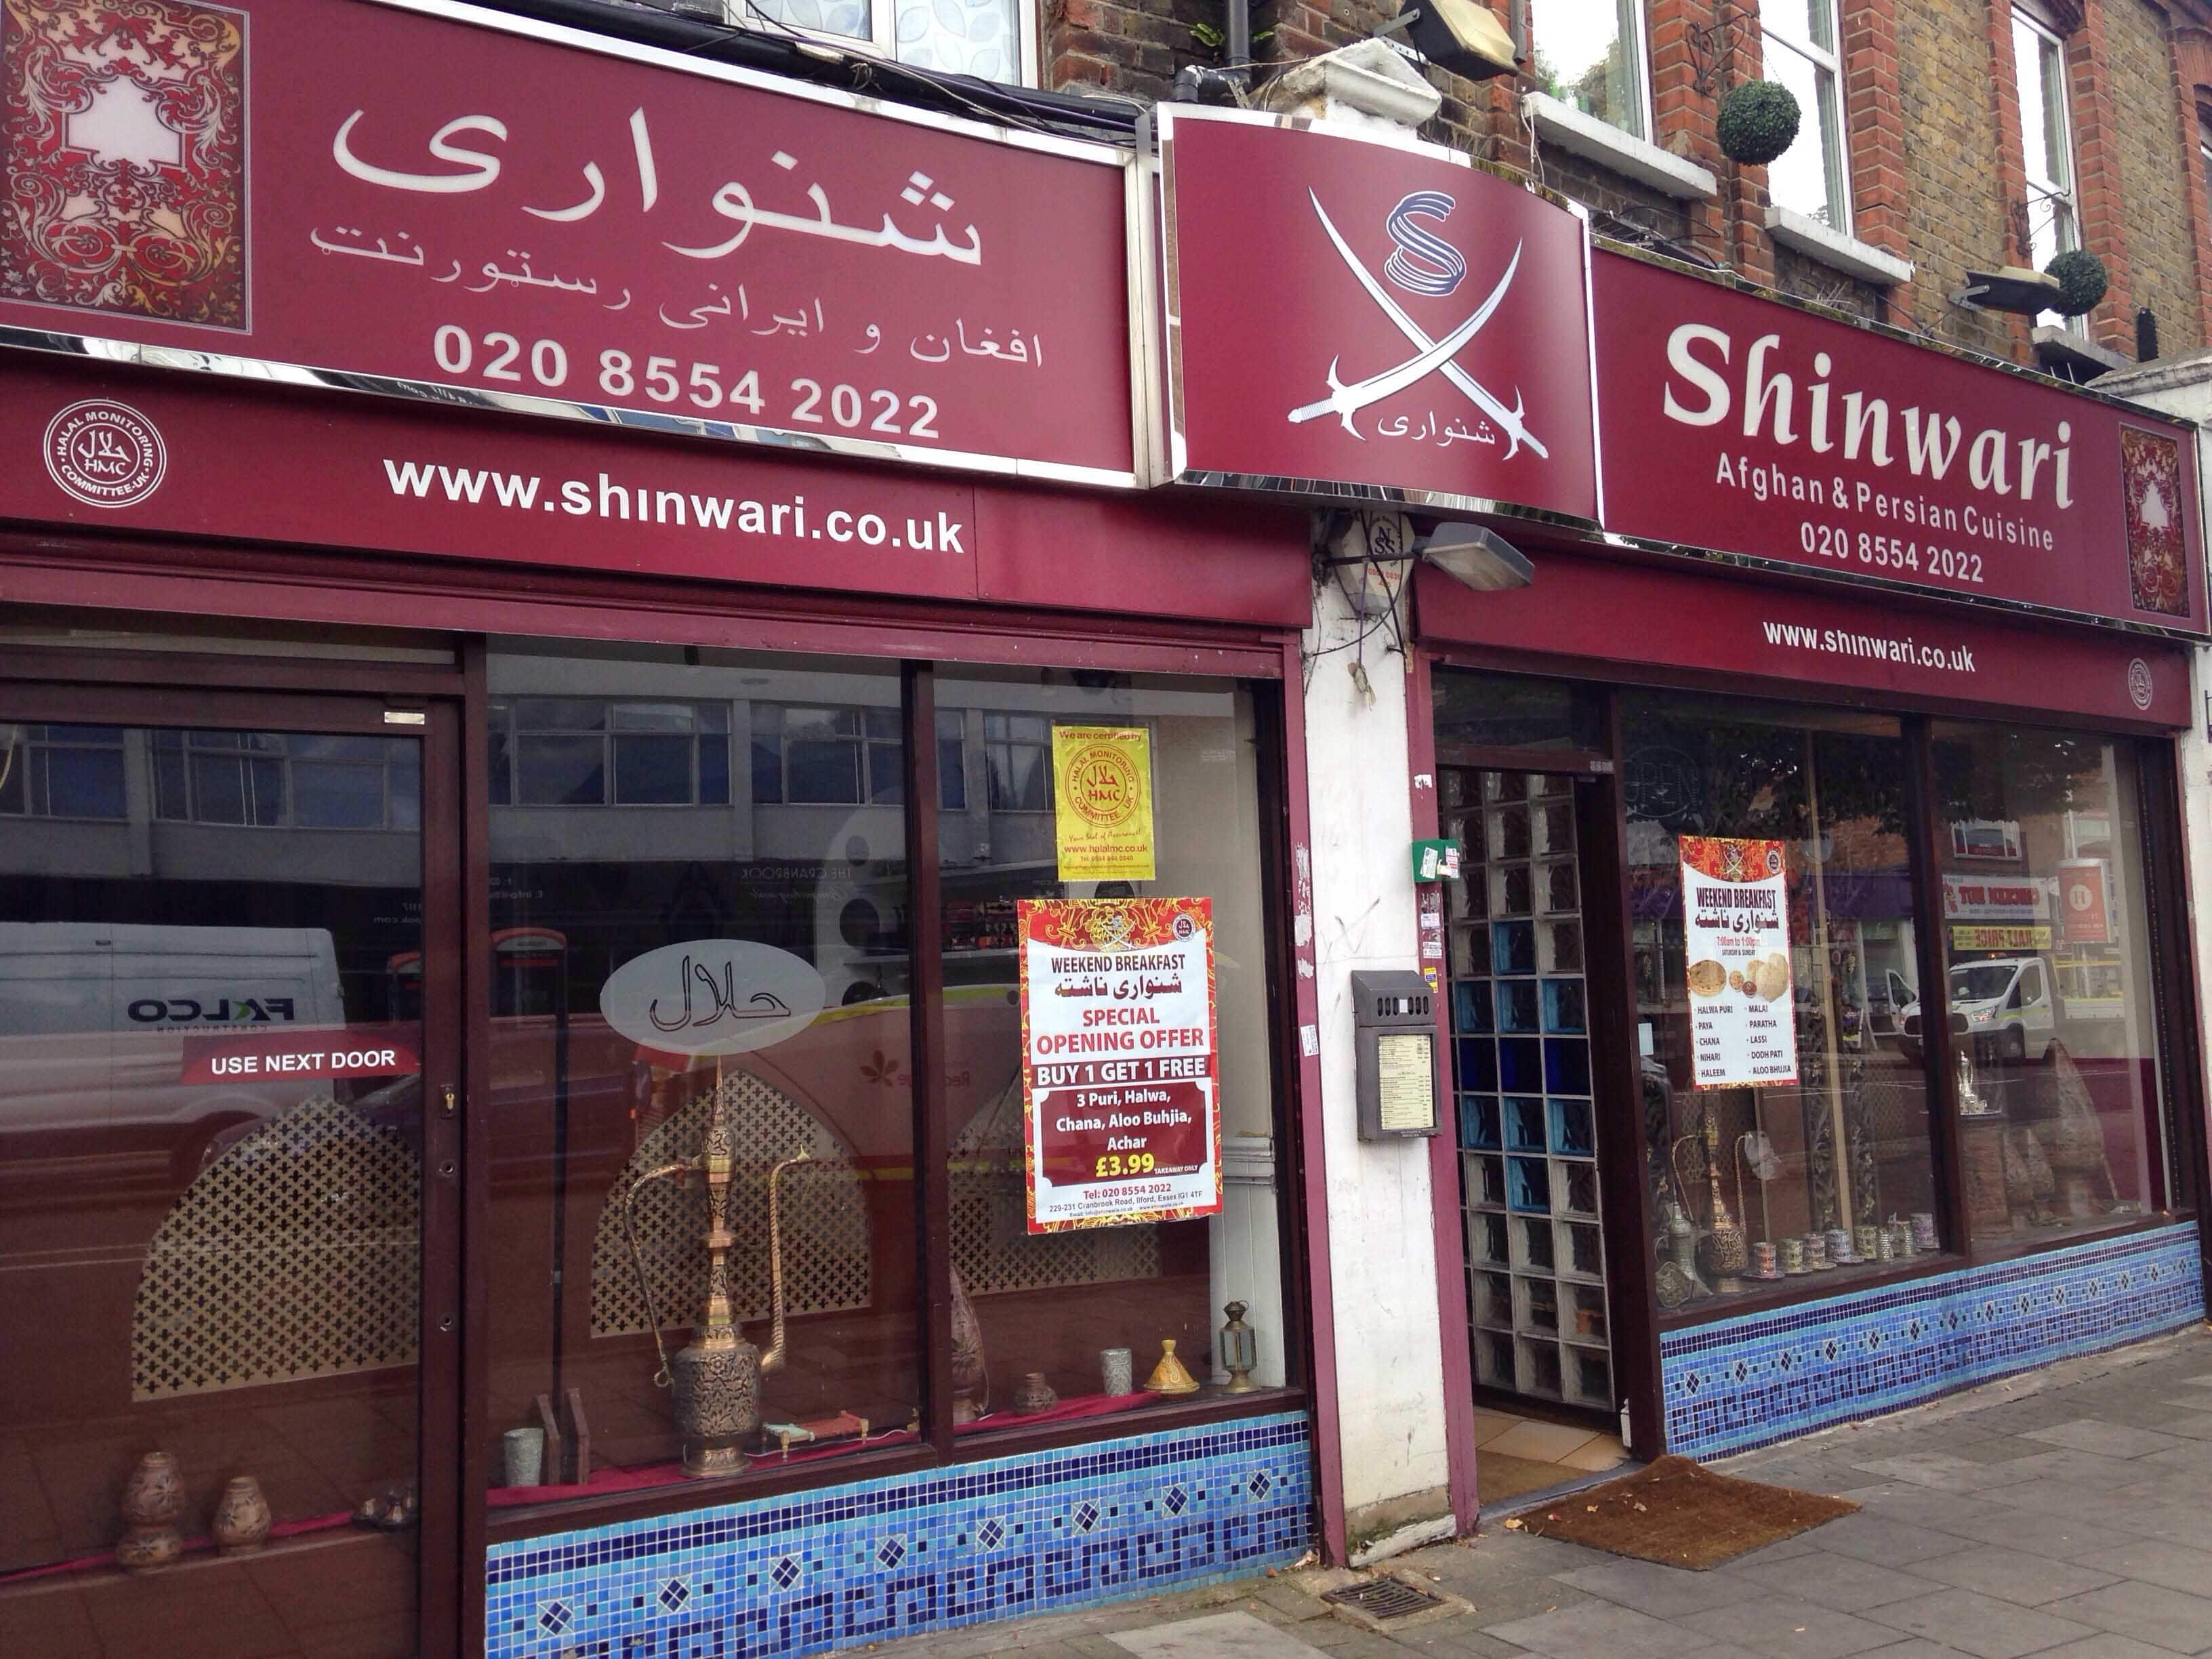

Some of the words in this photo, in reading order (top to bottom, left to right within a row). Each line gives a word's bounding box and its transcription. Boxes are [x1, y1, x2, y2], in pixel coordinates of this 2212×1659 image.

[434, 325, 568, 386] 020
[598, 349, 766, 414] 8554
[790, 377, 939, 439] 2022
[1663, 323, 2074, 510] Shinwari
[57, 417, 84, 456] HALAL
[85, 411, 153, 468] MONITORING
[84, 458, 126, 476] HMC
[1716, 452, 1824, 504] Afghan
[1832, 476, 1850, 510] &
[1856, 481, 1958, 533] Persian
[1964, 506, 2054, 552] Cuisine
[1801, 521, 1849, 558] 020
[1859, 535, 1919, 572] 8554
[1927, 547, 1984, 584] 2022
[1059, 731, 1075, 739] We
[1090, 750, 1134, 783] MONITORING
[1088, 790, 1120, 802] HMC
[1075, 796, 1121, 821] COMMITTEE
[1696, 887, 1732, 907] WEEKEND
[1734, 888, 1776, 909] BREAKFAST
[1052, 956, 1112, 973] WEEKEND
[1115, 954, 1185, 972] BREAKFAST
[1697, 1006, 1719, 1015] HALWA
[1719, 1005, 1733, 1013] PURI
[1748, 1004, 1768, 1012] MALAI
[1083, 1008, 1160, 1027] SPECIAL
[1698, 1022, 1713, 1030] PAYA
[1749, 1020, 1777, 1028] PARATHA
[1037, 1031, 1134, 1054] OPENING
[1140, 1028, 1204, 1050] OFFER
[1699, 1037, 1720, 1046] CHANA
[1750, 1035, 1767, 1044] LASSI
[211, 1054, 258, 1076] USE
[265, 1052, 325, 1073] NEXT
[330, 1048, 396, 1069] DOOR
[1700, 1053, 1721, 1062] NIHARI
[1038, 1065, 1079, 1086] BUY
[1085, 1065, 1094, 1083] 1
[1101, 1061, 1140, 1082] GET
[1145, 1061, 1153, 1079] 1
[1160, 1058, 1206, 1078] FREE
[1701, 1069, 1725, 1078] HALEEM
[1753, 1066, 1769, 1075] ALOO
[1769, 1065, 1791, 1073] BHUJIA
[1077, 1094, 1086, 1107] 3
[1089, 1091, 1122, 1107] Puri,
[1125, 1088, 1171, 1105] Halwa,
[1056, 1117, 1105, 1132] Chana,
[1109, 1114, 1141, 1128] Aloo
[1144, 1109, 1192, 1127] Buhjia,
[1107, 1136, 1147, 1151] Achar
[1096, 1153, 1155, 1178] £3.99
[1154, 1166, 1184, 1175] TAKEAWAY
[1084, 1189, 1101, 1200] Tel:
[1102, 1187, 1120, 1198] 020
[1122, 1185, 1145, 1196] 8554
[1148, 1183, 1172, 1193] 2022
[1078, 1200, 1113, 1210] Cranbrook
